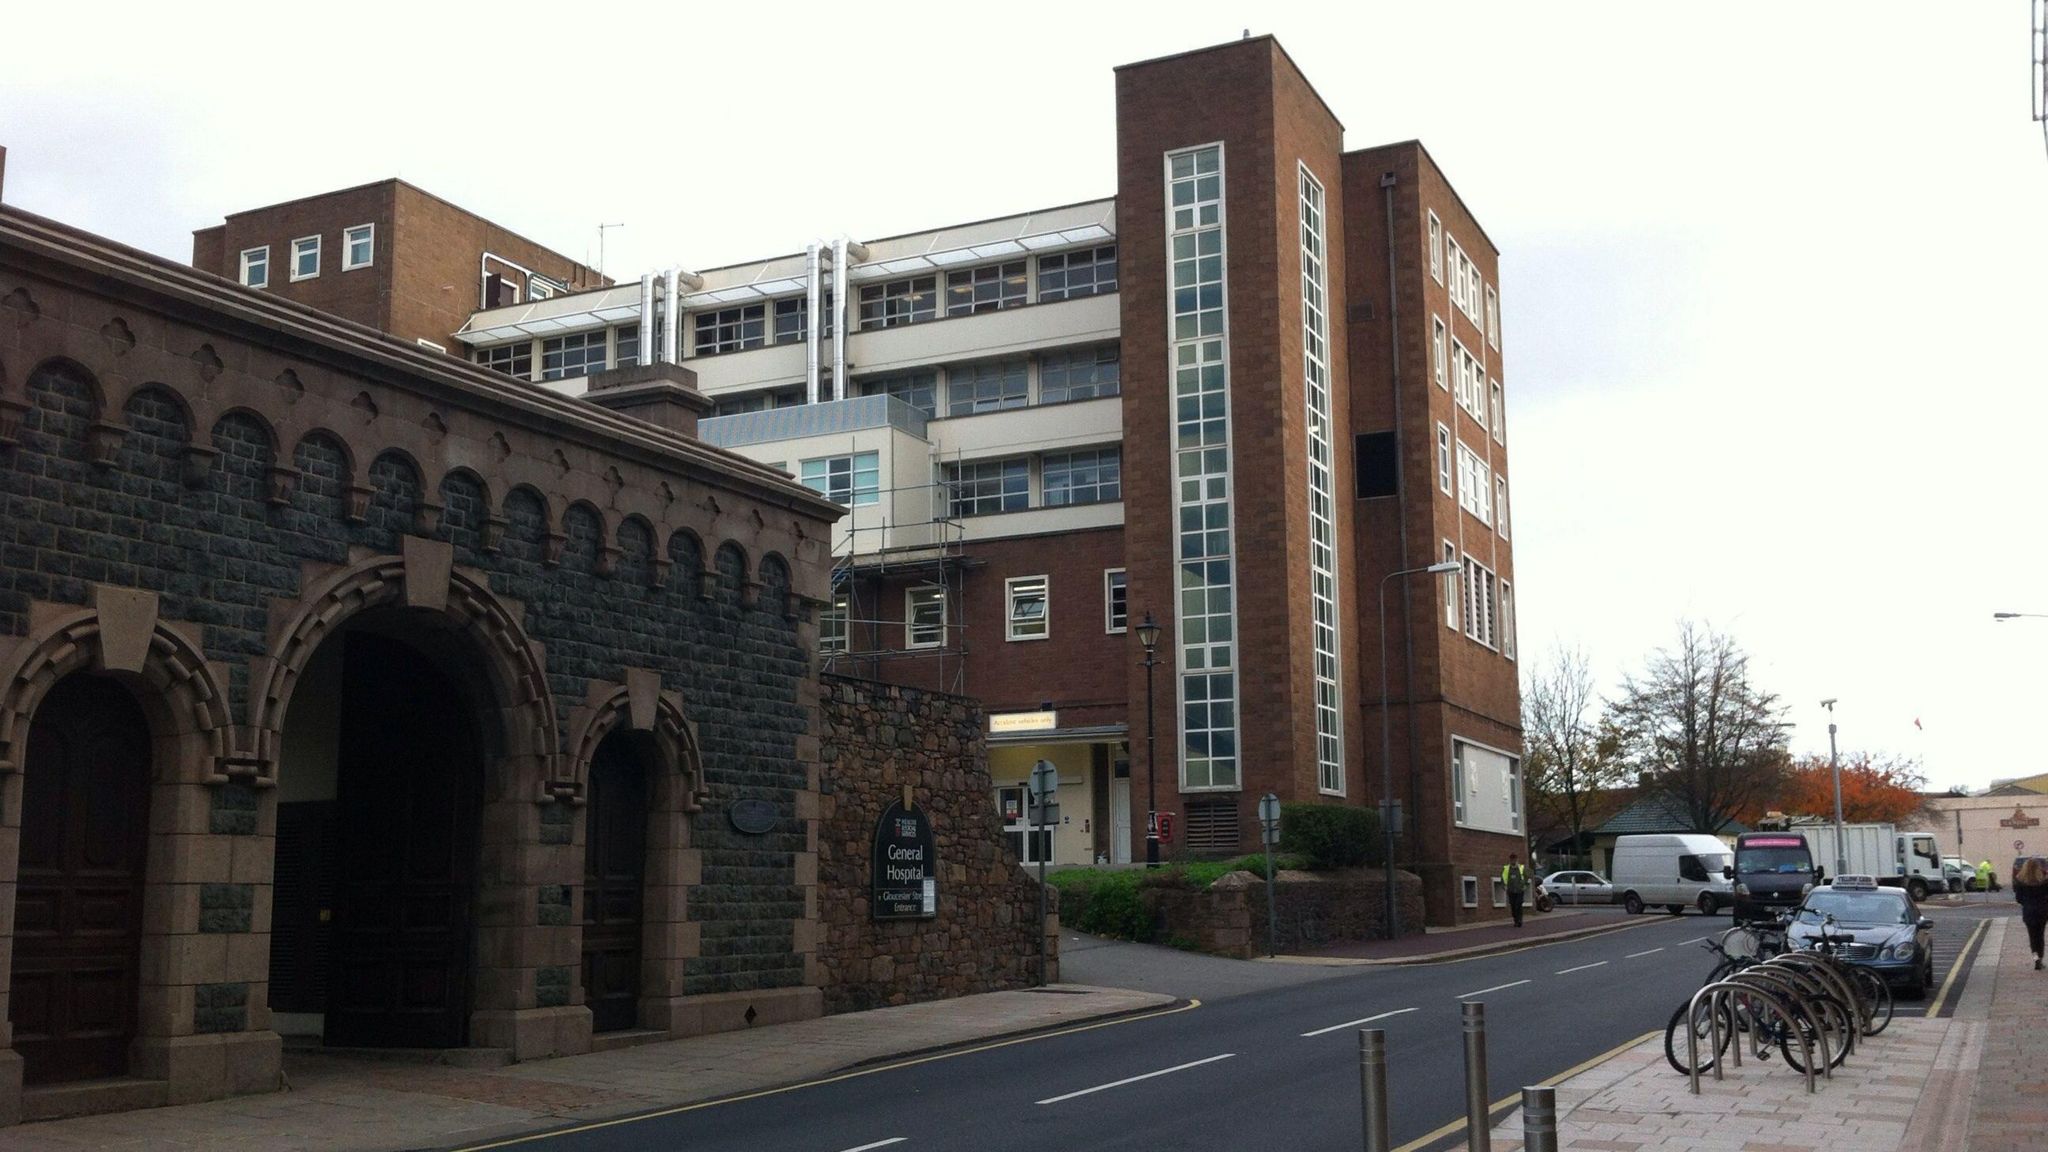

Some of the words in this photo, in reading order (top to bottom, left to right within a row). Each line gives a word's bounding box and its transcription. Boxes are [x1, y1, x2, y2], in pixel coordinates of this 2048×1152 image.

[888, 844, 923, 861] General
[887, 864, 924, 884] Hospital
[883, 891, 911, 901] Gloucester
[894, 902, 917, 912] Entrance
